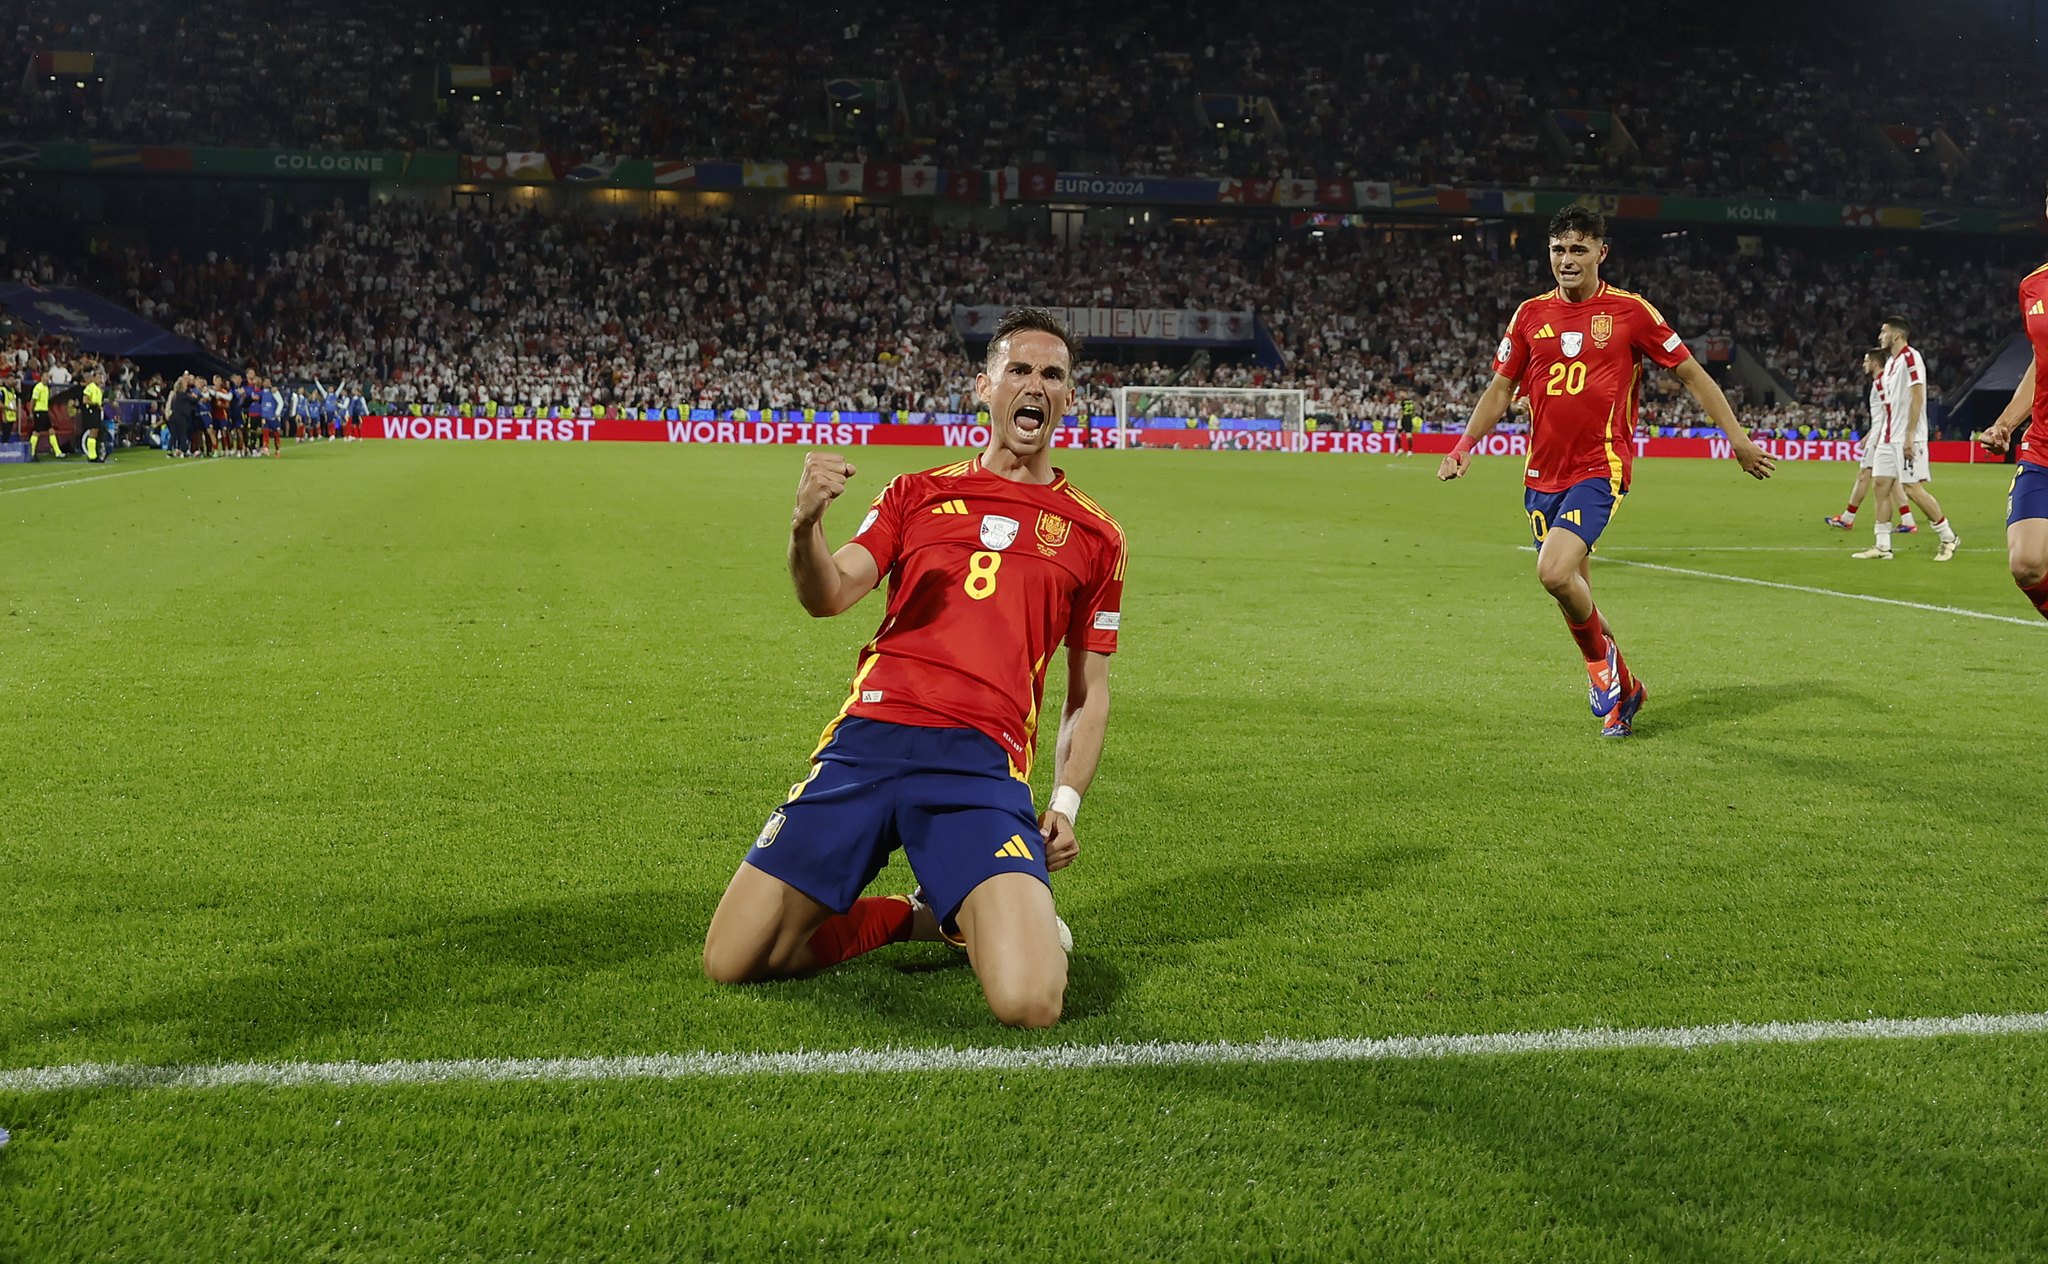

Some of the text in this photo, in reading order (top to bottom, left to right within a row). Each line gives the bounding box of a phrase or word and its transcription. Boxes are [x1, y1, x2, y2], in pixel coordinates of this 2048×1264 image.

[274, 154, 383, 171] COLOGNE
[1726, 203, 1776, 220] KÖLN
[1052, 308, 1179, 338] LIEVE
[1546, 361, 1587, 396] 20
[383, 417, 596, 441] WORLDFIRST
[667, 421, 874, 445] WORLDFIRST
[942, 425, 1144, 449] WOFIRST
[1209, 430, 1397, 454] WORLDFIRST
[963, 551, 1002, 600] 8
